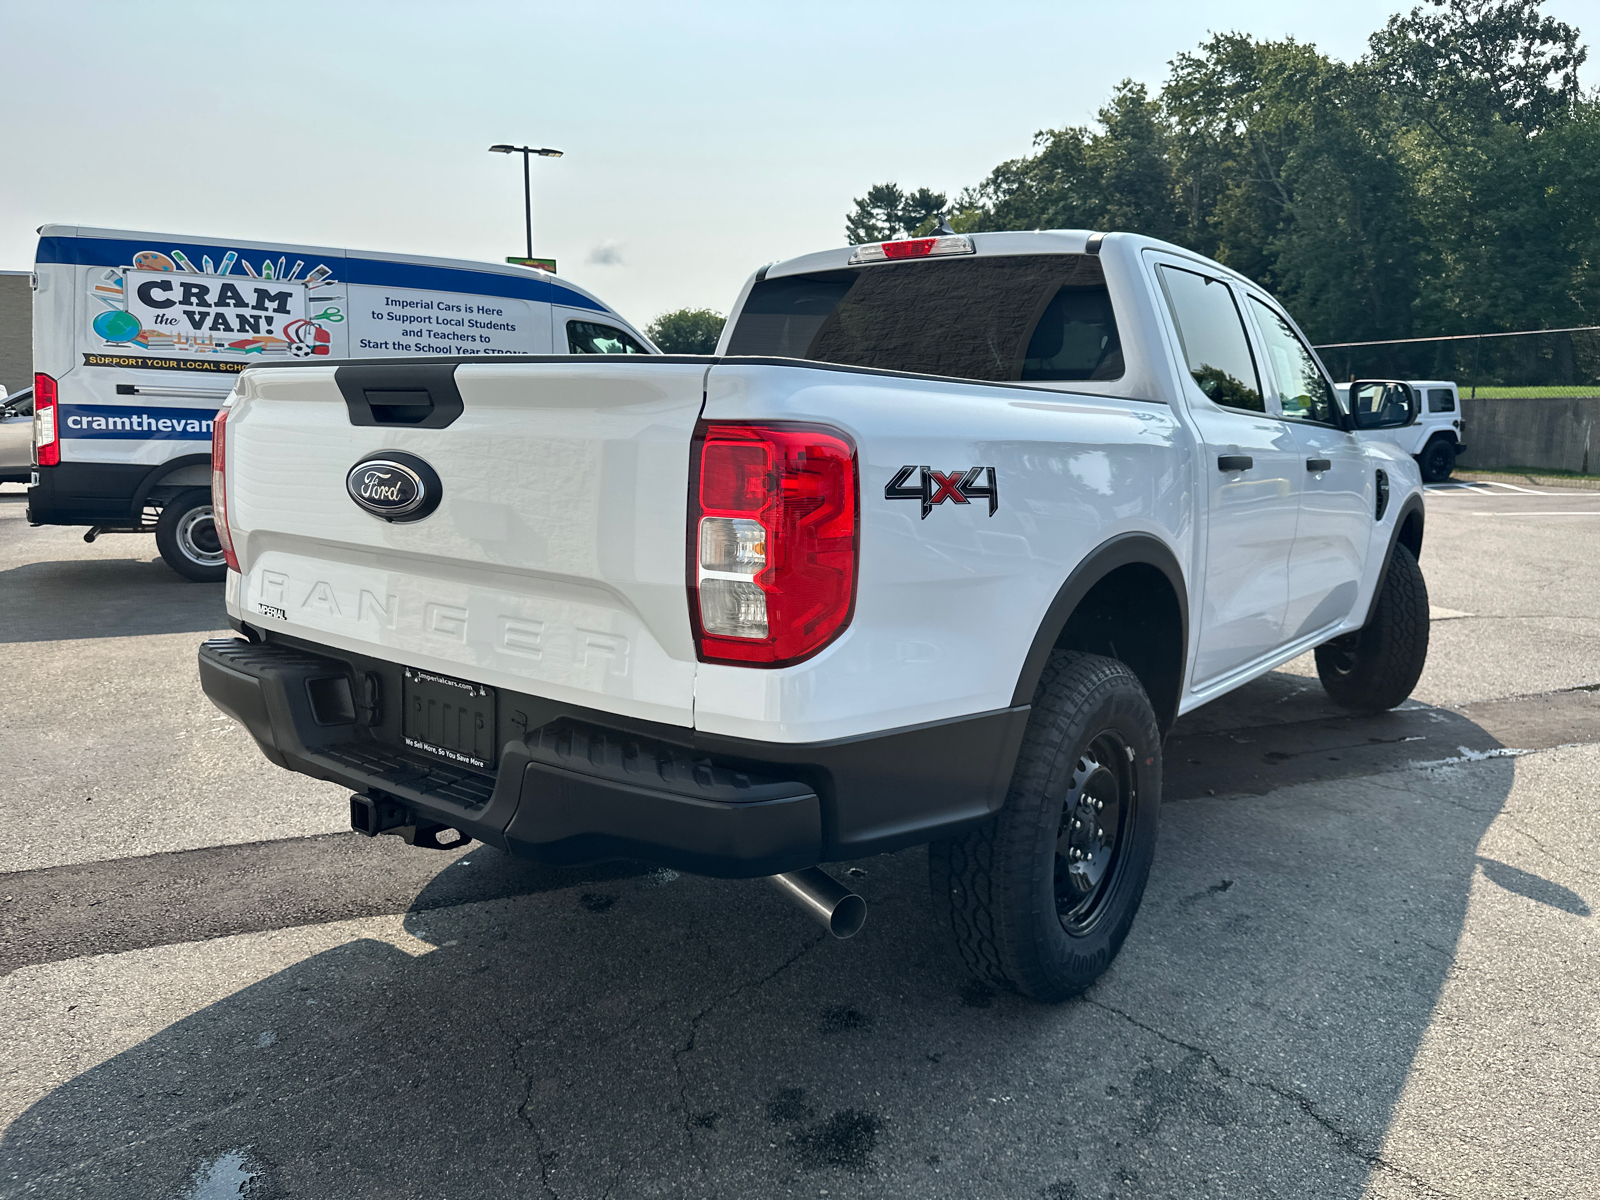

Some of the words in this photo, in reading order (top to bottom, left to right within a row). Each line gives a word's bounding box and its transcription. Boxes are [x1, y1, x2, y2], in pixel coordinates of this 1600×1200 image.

[137, 280, 293, 315] CRAM
[384, 297, 433, 310] Imperial
[437, 301, 462, 313] Cars
[465, 303, 474, 314] is
[477, 305, 503, 316] Here
[154, 313, 180, 326] the
[183, 310, 274, 335] VAN!
[371, 310, 384, 320] to
[387, 312, 432, 325] Support
[436, 316, 465, 327] Local
[467, 318, 516, 332] Students
[359, 339, 388, 350] Start
[392, 341, 411, 351] the
[414, 343, 452, 355] School
[455, 346, 481, 355] Year
[402, 328, 423, 338] and
[426, 329, 477, 343] Teachers
[479, 334, 491, 344] to
[89, 356, 144, 367] SUPPORT
[146, 359, 177, 368] YOUR
[180, 361, 217, 370] LOCAL
[361, 471, 401, 501] Ford
[260, 569, 630, 677] RANGER
[418, 671, 473, 691] Imperialcars.com
[405, 738, 413, 747] We
[414, 740, 422, 749] Sell
[423, 743, 438, 755] More,
[438, 748, 445, 756] So
[445, 750, 456, 759] You
[456, 754, 470, 764] Save
[470, 758, 484, 768] More
